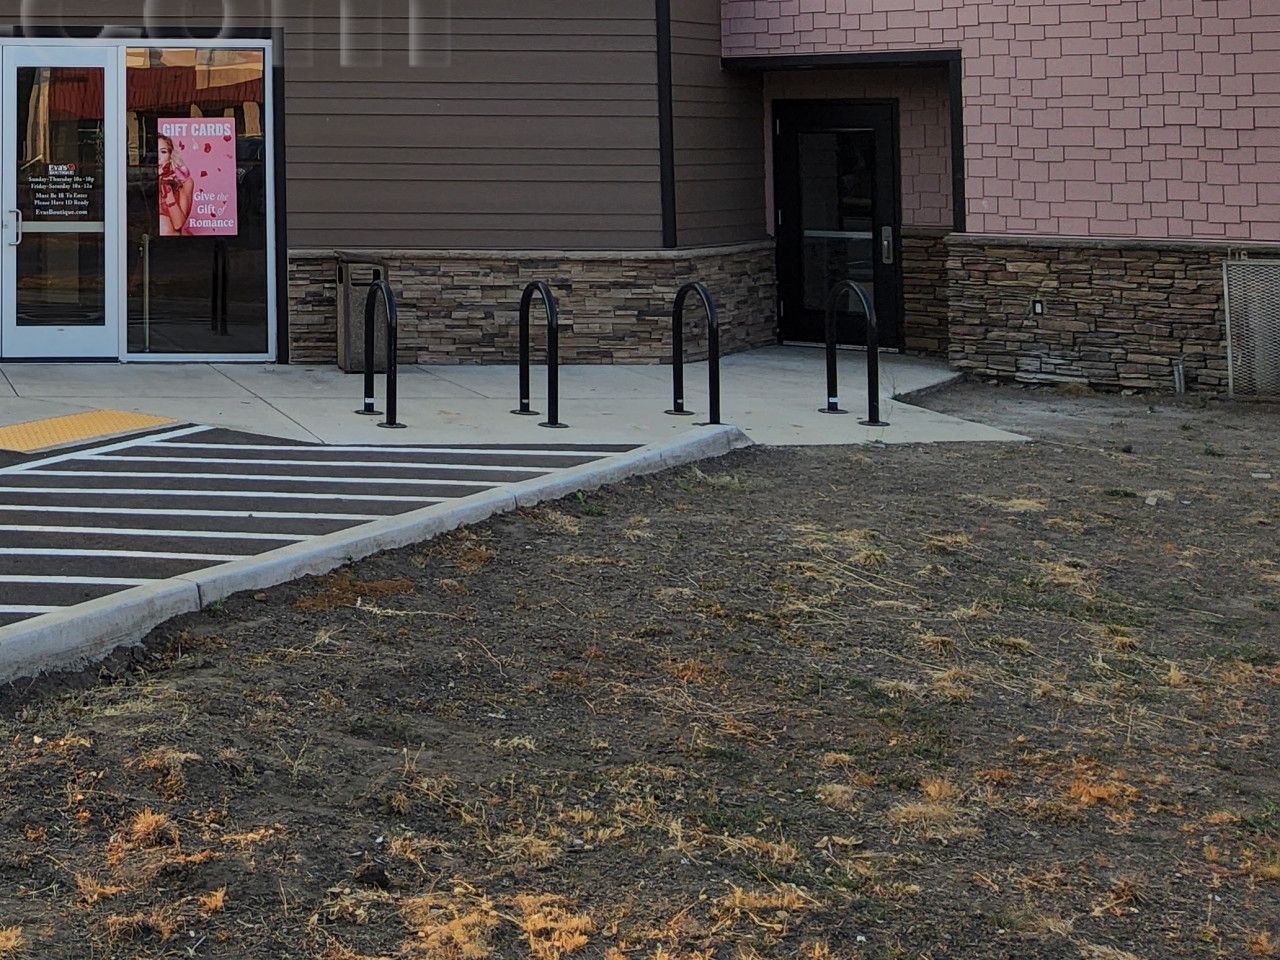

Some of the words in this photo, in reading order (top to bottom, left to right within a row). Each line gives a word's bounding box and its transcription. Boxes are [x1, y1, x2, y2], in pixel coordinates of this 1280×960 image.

[162, 123, 187, 137] GIFT
[191, 123, 232, 137] CARDS
[192, 192, 216, 201] Give
[197, 205, 215, 214] Gift
[189, 219, 234, 228] Romance
